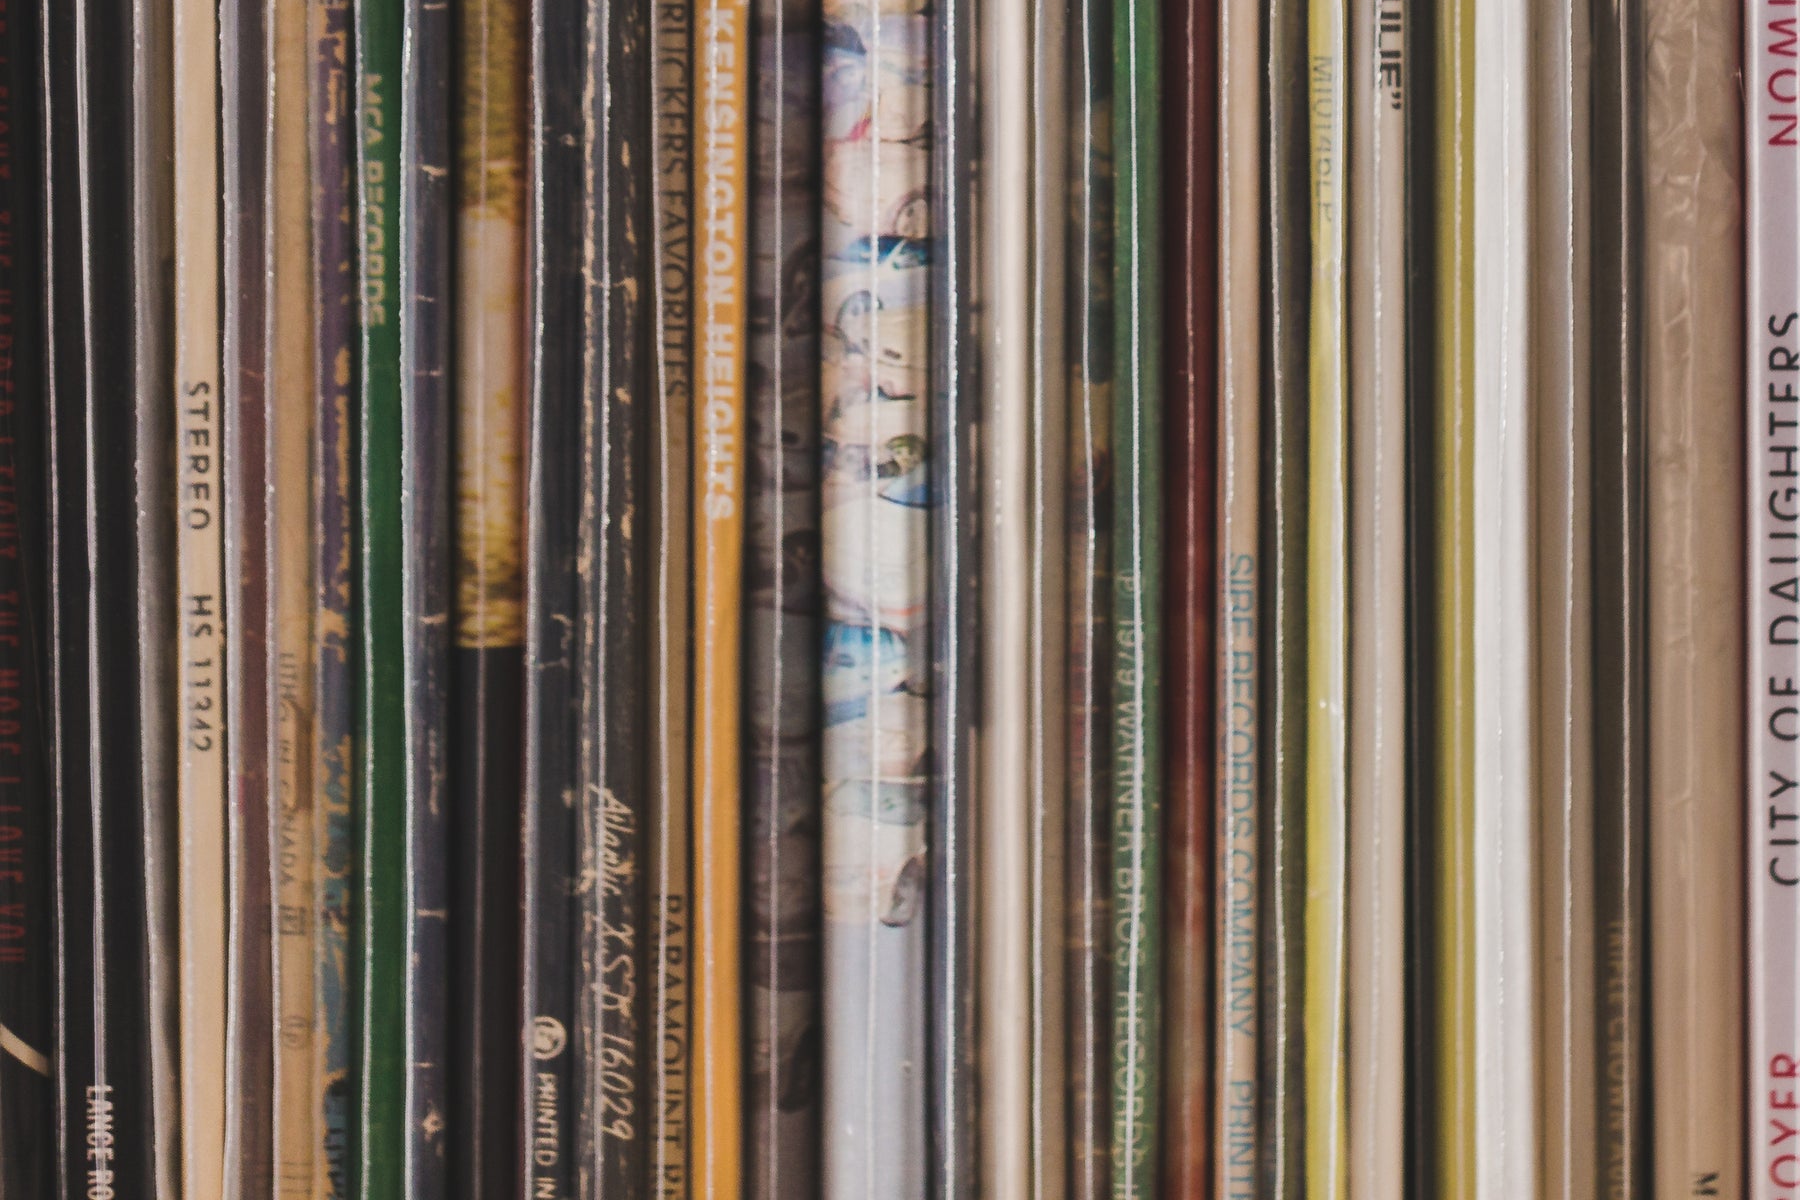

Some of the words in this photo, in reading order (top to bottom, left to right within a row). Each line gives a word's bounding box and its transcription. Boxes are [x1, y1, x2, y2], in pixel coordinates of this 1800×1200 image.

[360, 73, 384, 145] MCA
[703, 8, 734, 305] KENSINGTON
[360, 160, 385, 328] RECORDS
[662, 188, 688, 400] FAVORITES
[183, 383, 211, 530] STEREO
[703, 324, 734, 522] HEIGHTS
[187, 594, 213, 638] HS
[1114, 617, 1142, 686] 1979
[1222, 552, 1256, 641] SIRE
[187, 655, 213, 752] 11342
[1221, 650, 1254, 842] RECORDS
[1113, 697, 1143, 856] WARNER
[1222, 847, 1254, 1036] COMPANY
[598, 1032, 636, 1141] 16029
[652, 893, 682, 1147] PARAMOUNT
[1112, 989, 1145, 1168] RECORDS
[85, 1085, 112, 1161] LANCE
[533, 1073, 557, 1167] PRINTED
[1228, 1078, 1255, 1200] PRINT
[1692, 1170, 1719, 1197] M
